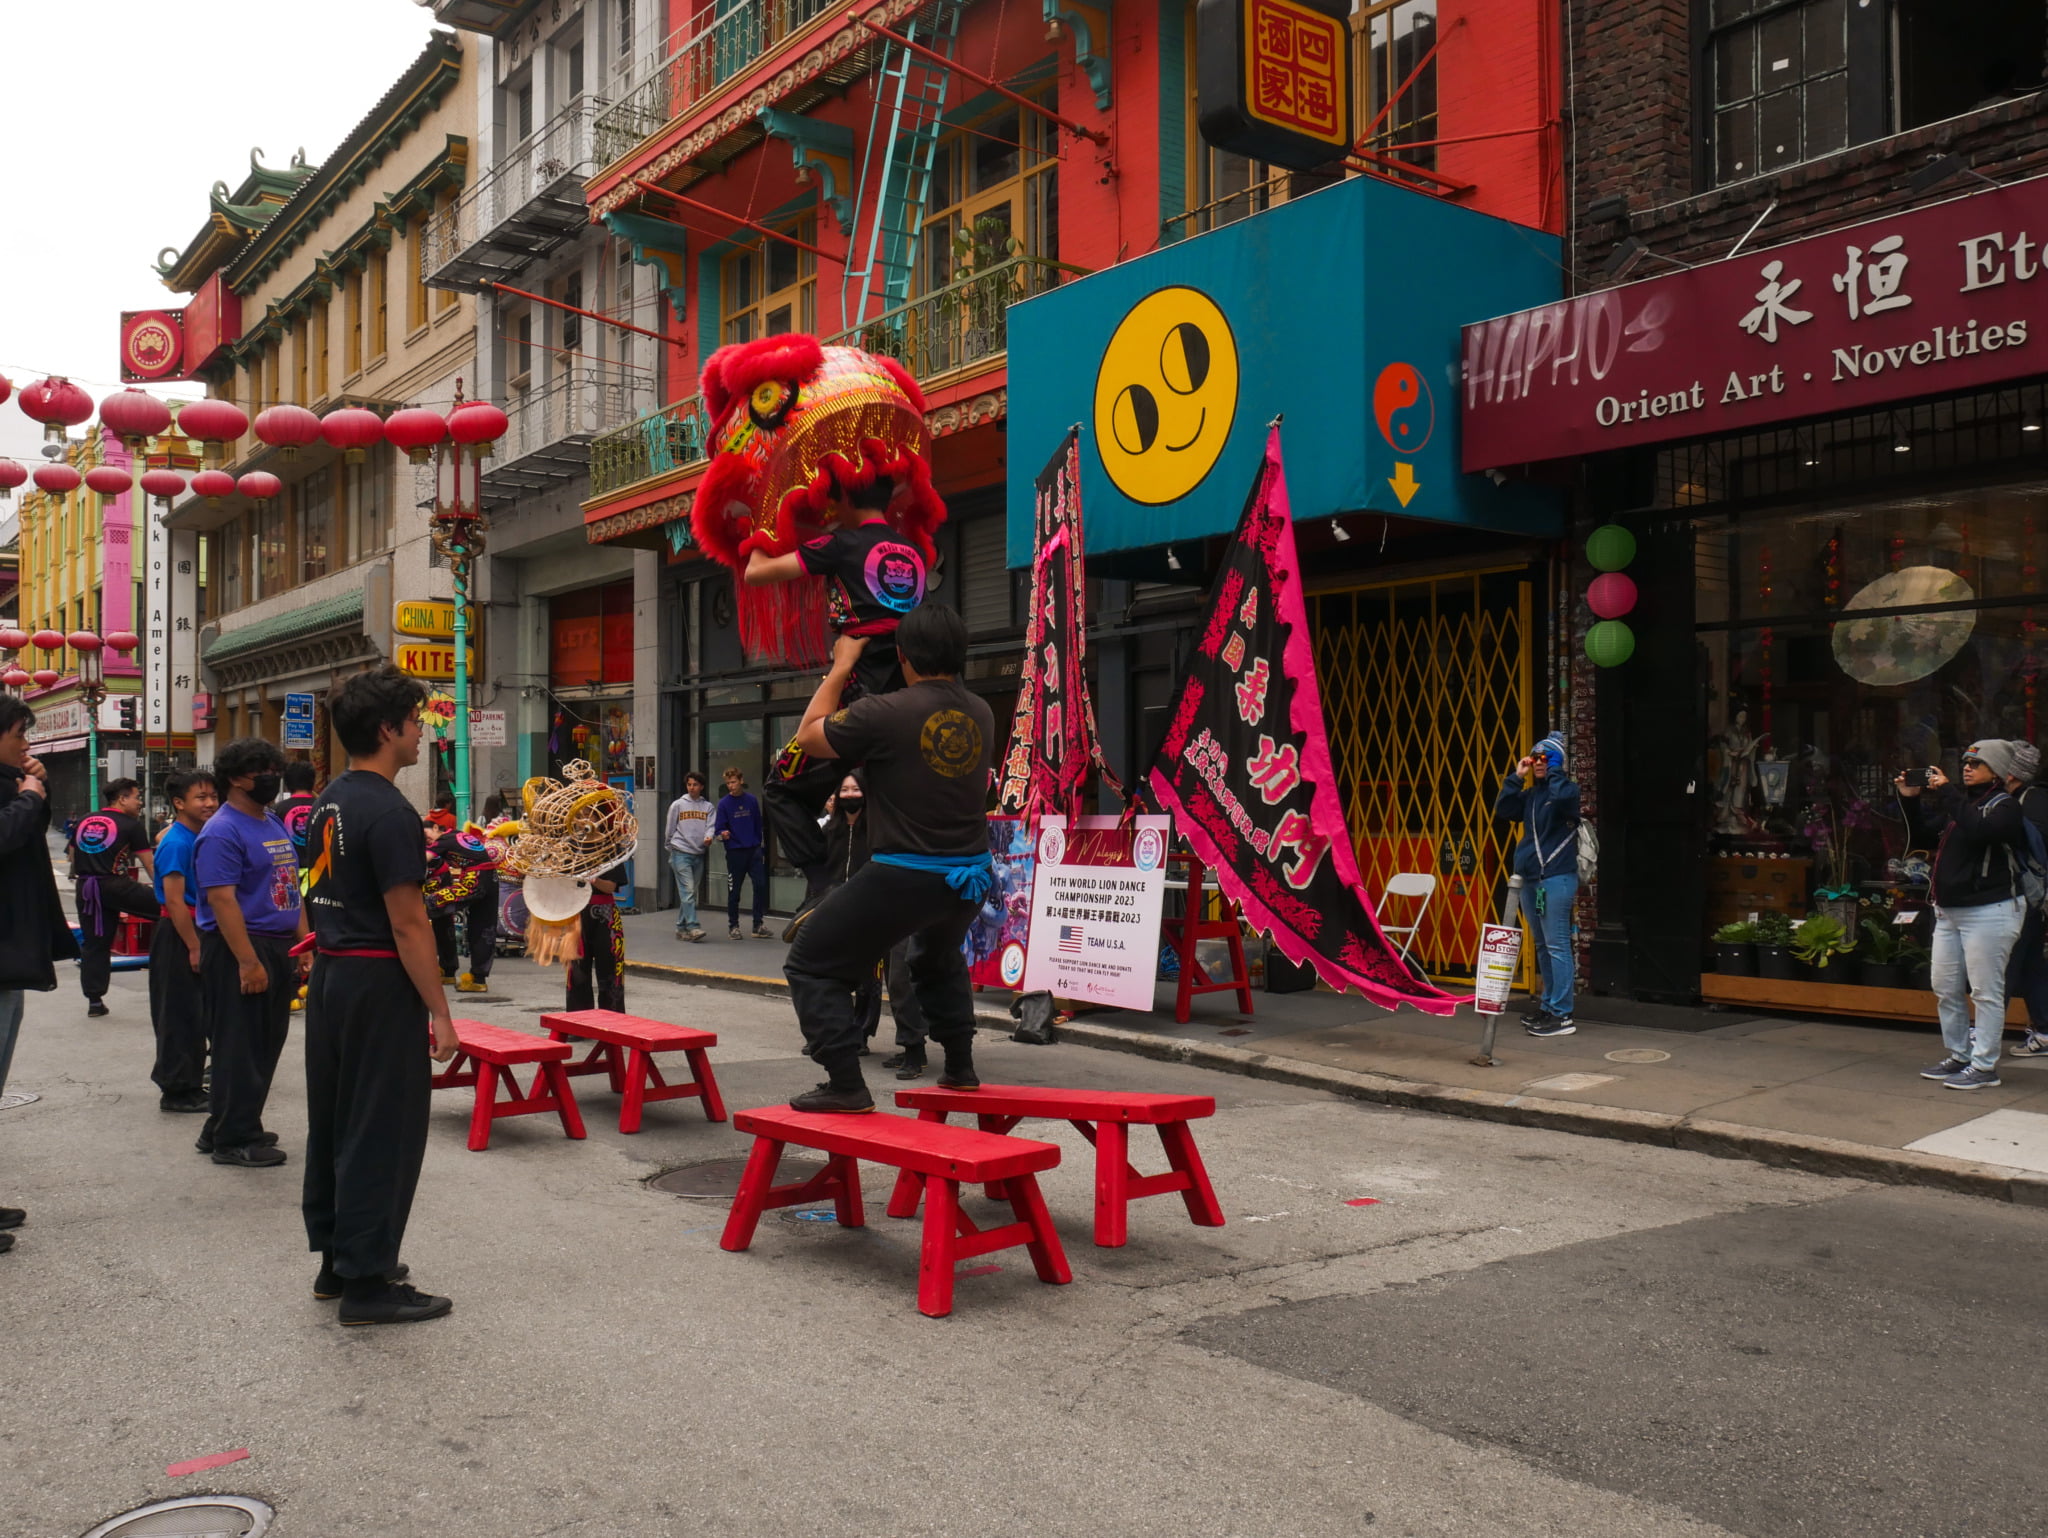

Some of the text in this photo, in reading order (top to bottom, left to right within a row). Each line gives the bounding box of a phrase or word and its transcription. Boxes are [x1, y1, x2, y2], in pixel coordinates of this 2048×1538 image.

[1958, 231, 2048, 293] Et
[1831, 319, 2028, 383] Novelties
[1595, 363, 1785, 427] Orient Art
[153, 561, 161, 590] of
[403, 606, 472, 632] CHINA TON
[151, 610, 162, 725] America
[406, 650, 468, 673] KITE
[470, 711, 481, 721] NO
[1049, 876, 1146, 893] 14TH WORLD LION DANCE
[1054, 890, 1135, 907] CHAMPIONSHIP 2023
[1087, 936, 1126, 951] TEAM U.S.A.
[1484, 943, 1496, 952] NO
[1057, 978, 1068, 989] 4-6
